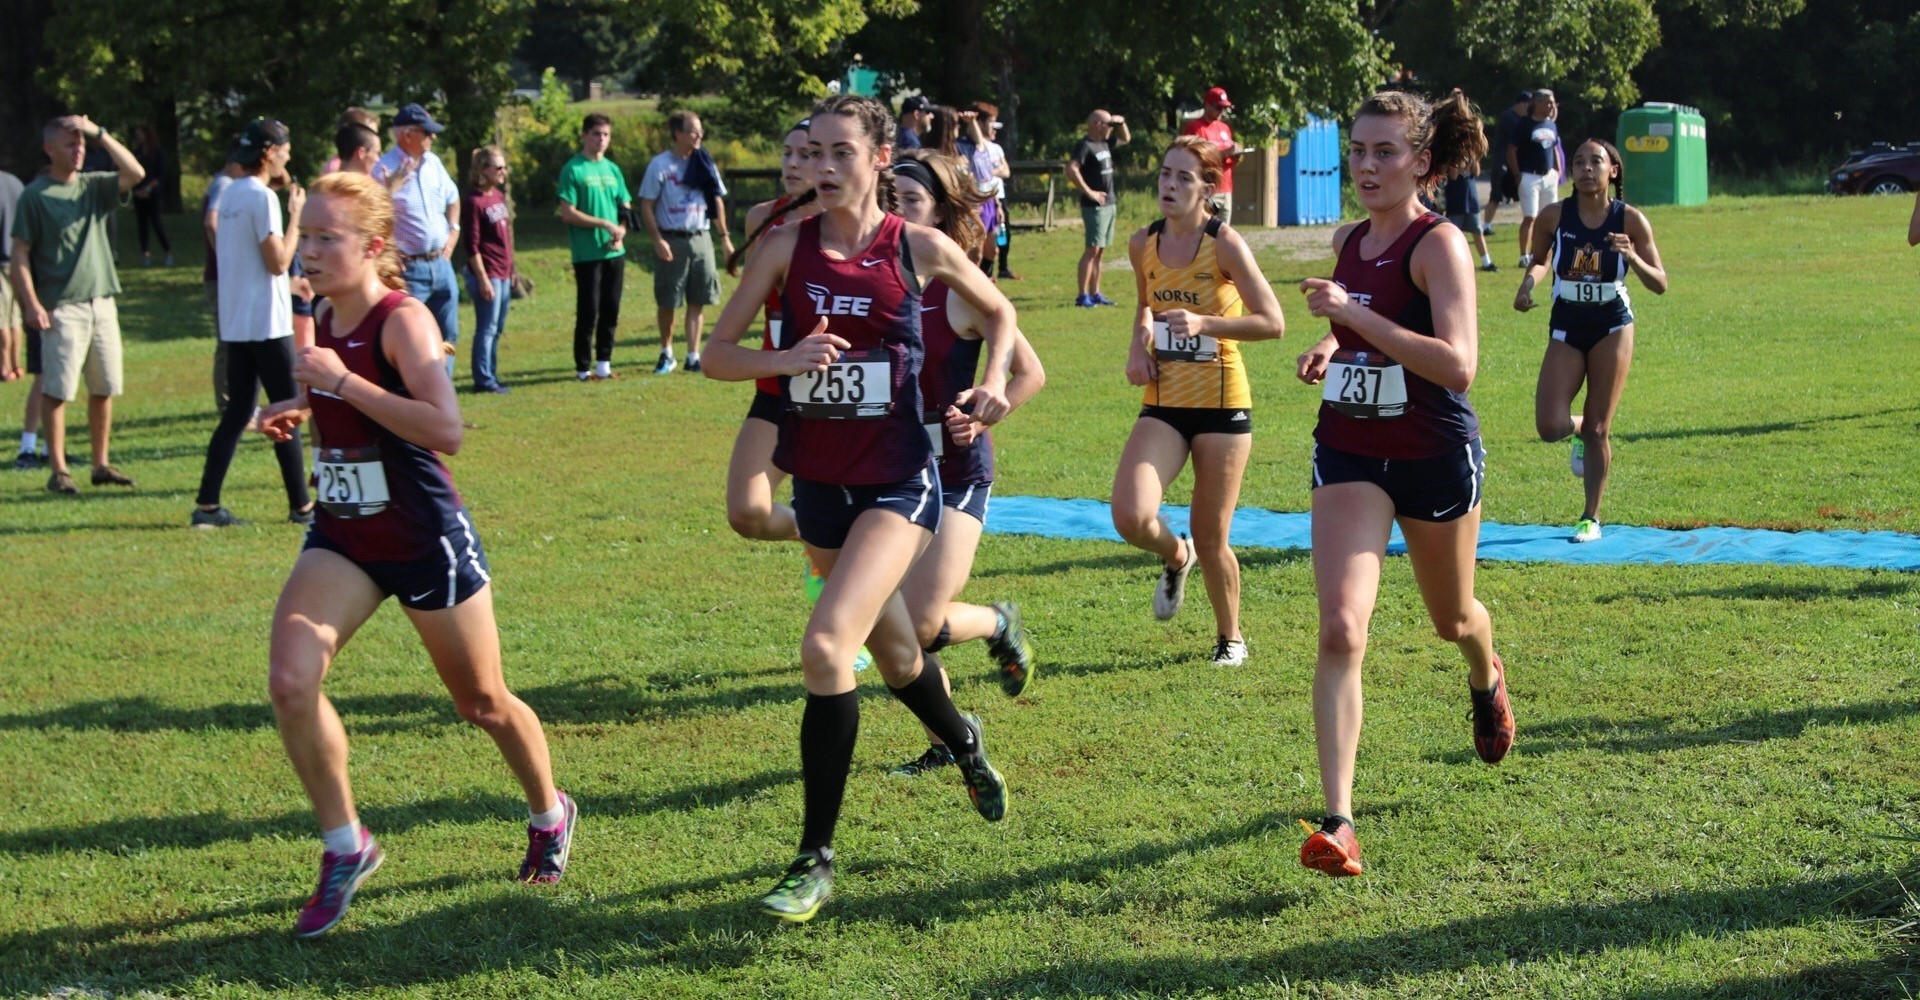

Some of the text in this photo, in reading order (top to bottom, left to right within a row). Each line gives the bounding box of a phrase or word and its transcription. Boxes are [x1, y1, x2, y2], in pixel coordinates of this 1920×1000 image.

[815, 295, 872, 316] LEE
[1153, 290, 1200, 305] NORSE
[1575, 283, 1602, 301] 191
[807, 365, 865, 403] 253
[1340, 366, 1382, 404] 237
[323, 465, 364, 502] 251
